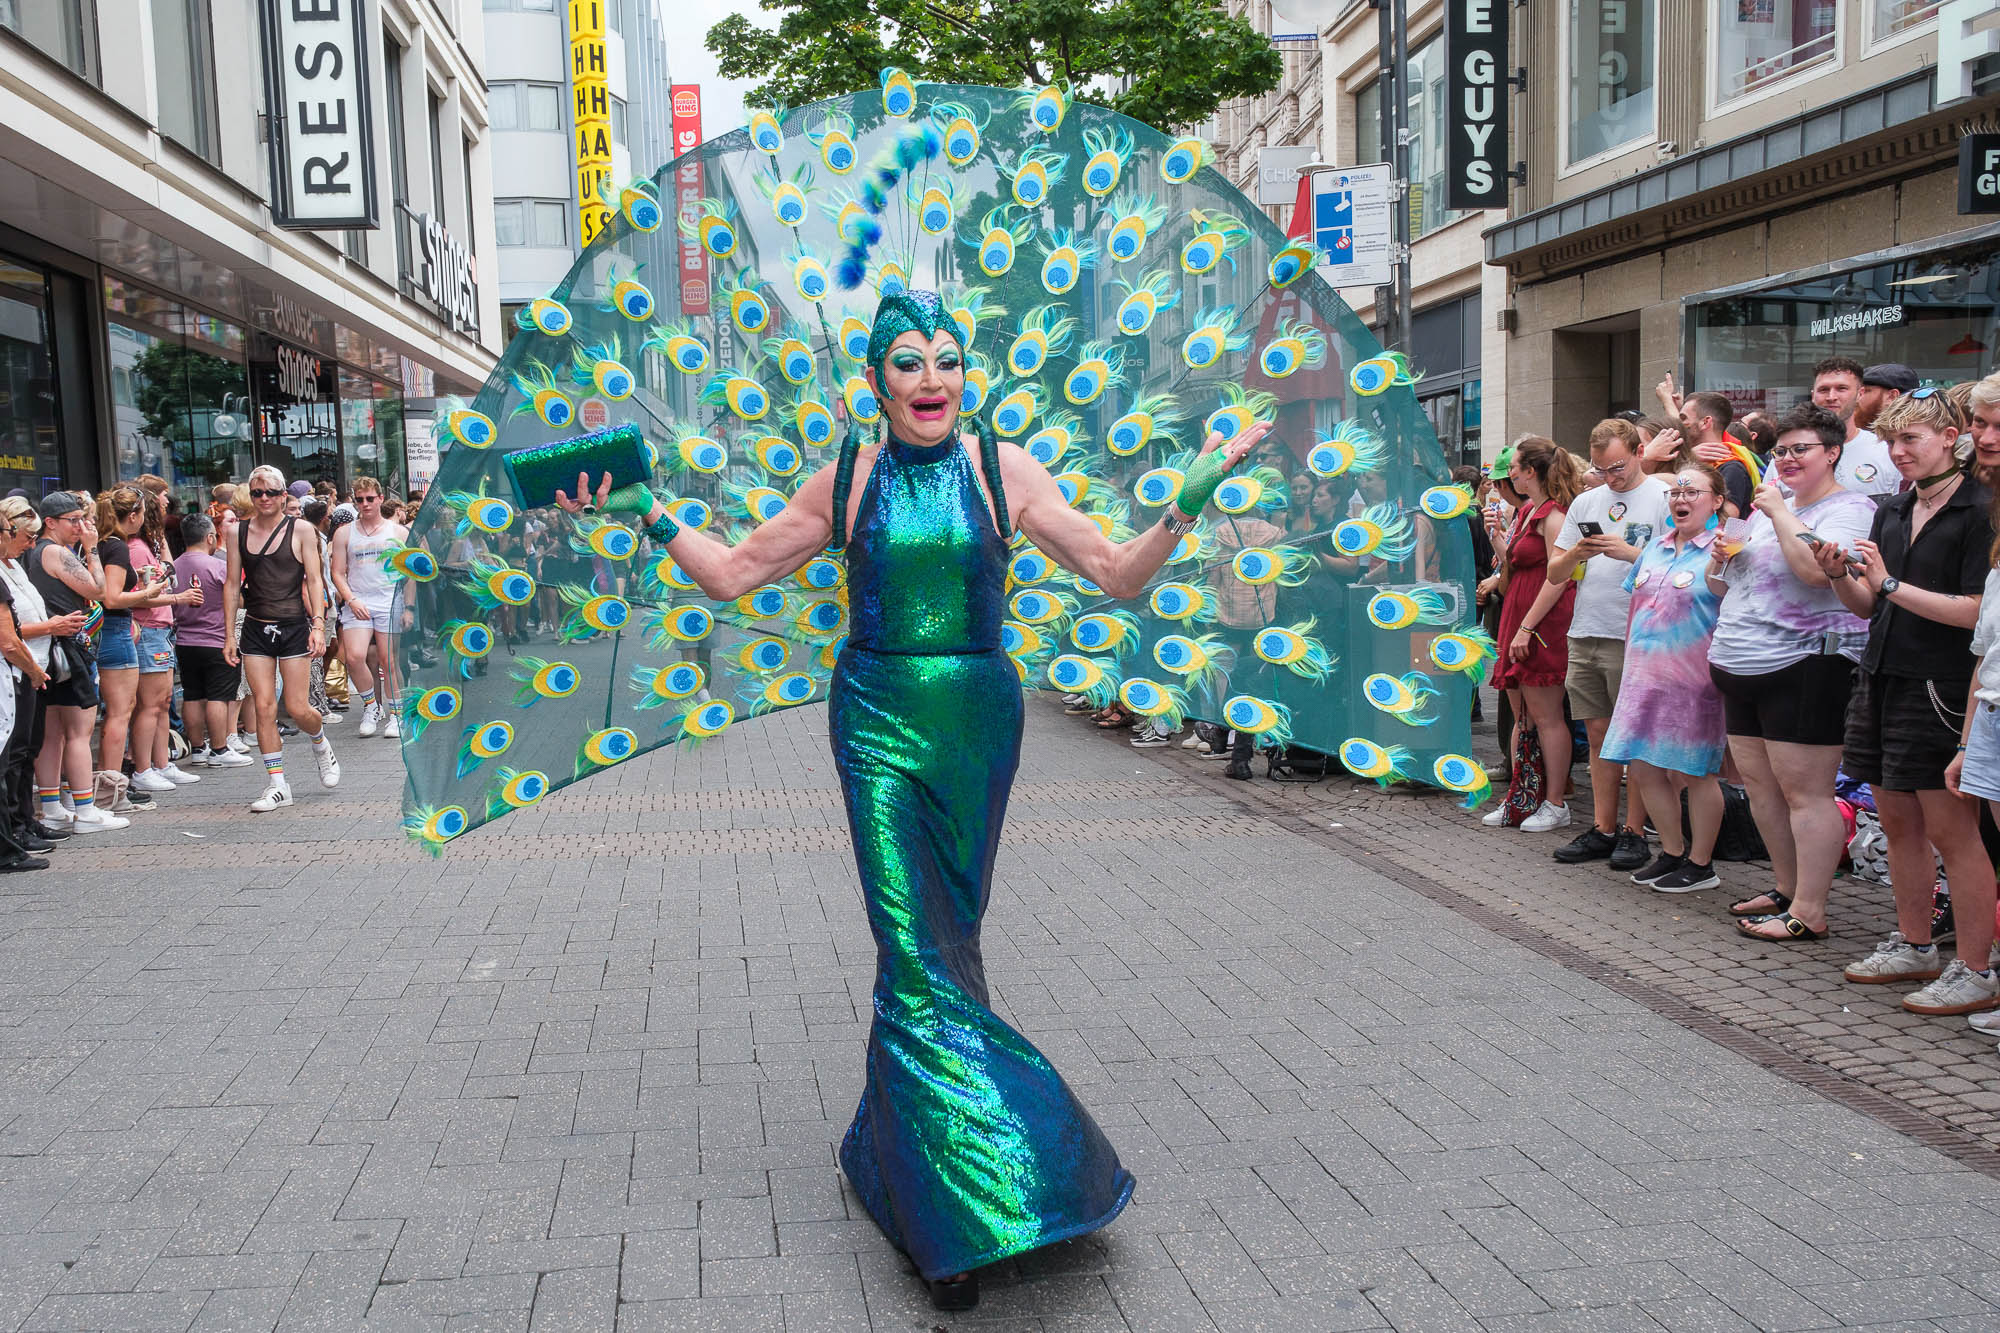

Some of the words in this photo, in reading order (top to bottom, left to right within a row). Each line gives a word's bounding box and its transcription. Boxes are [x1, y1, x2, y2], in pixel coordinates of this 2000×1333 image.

[676, 104, 697, 112] KING
[1464, 50, 1496, 195] GUYS
[424, 212, 476, 332] snipes
[1810, 305, 1903, 337] MILKSHAKES
[277, 344, 319, 405] snipes
[584, 415, 606, 423] KING
